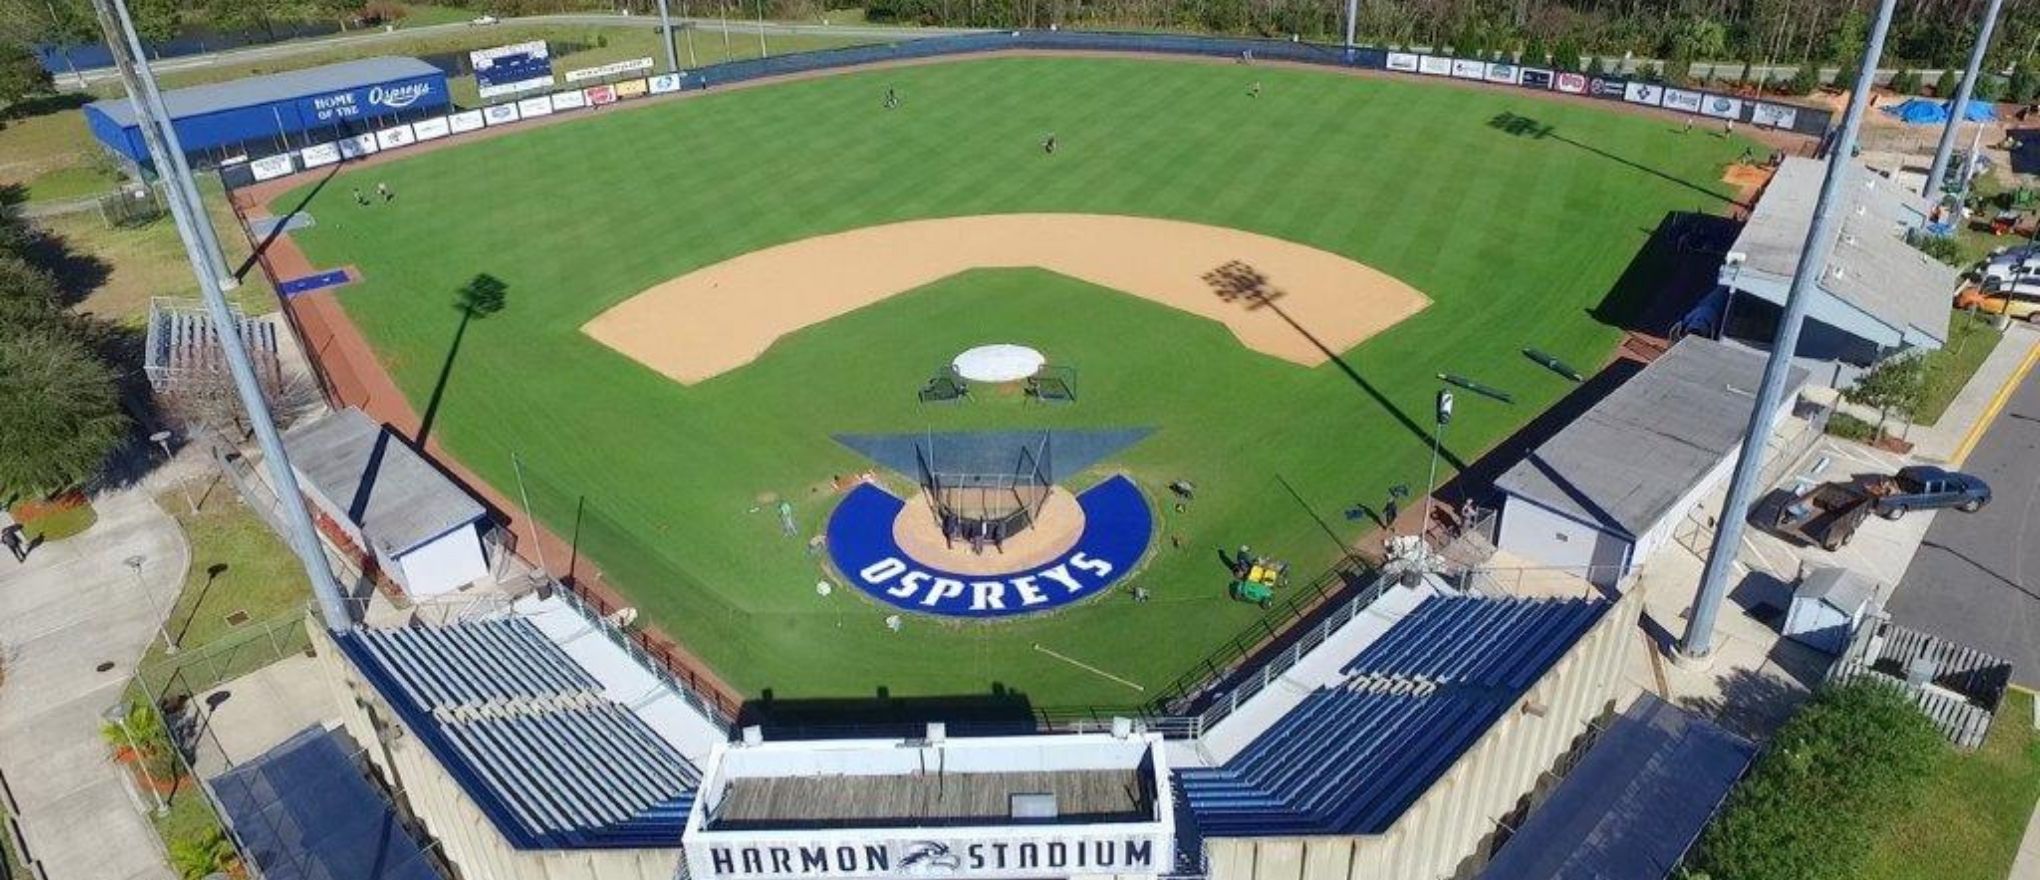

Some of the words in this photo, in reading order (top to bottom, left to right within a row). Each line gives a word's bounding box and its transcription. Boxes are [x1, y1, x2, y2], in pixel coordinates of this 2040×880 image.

[314, 93, 355, 110] HOME
[368, 82, 431, 108] Ospreys
[318, 109, 333, 120] OF
[336, 104, 359, 117] THE
[860, 551, 1113, 610] OSPREYS
[709, 844, 890, 875] HARMON
[967, 839, 1153, 870] STADIUM
